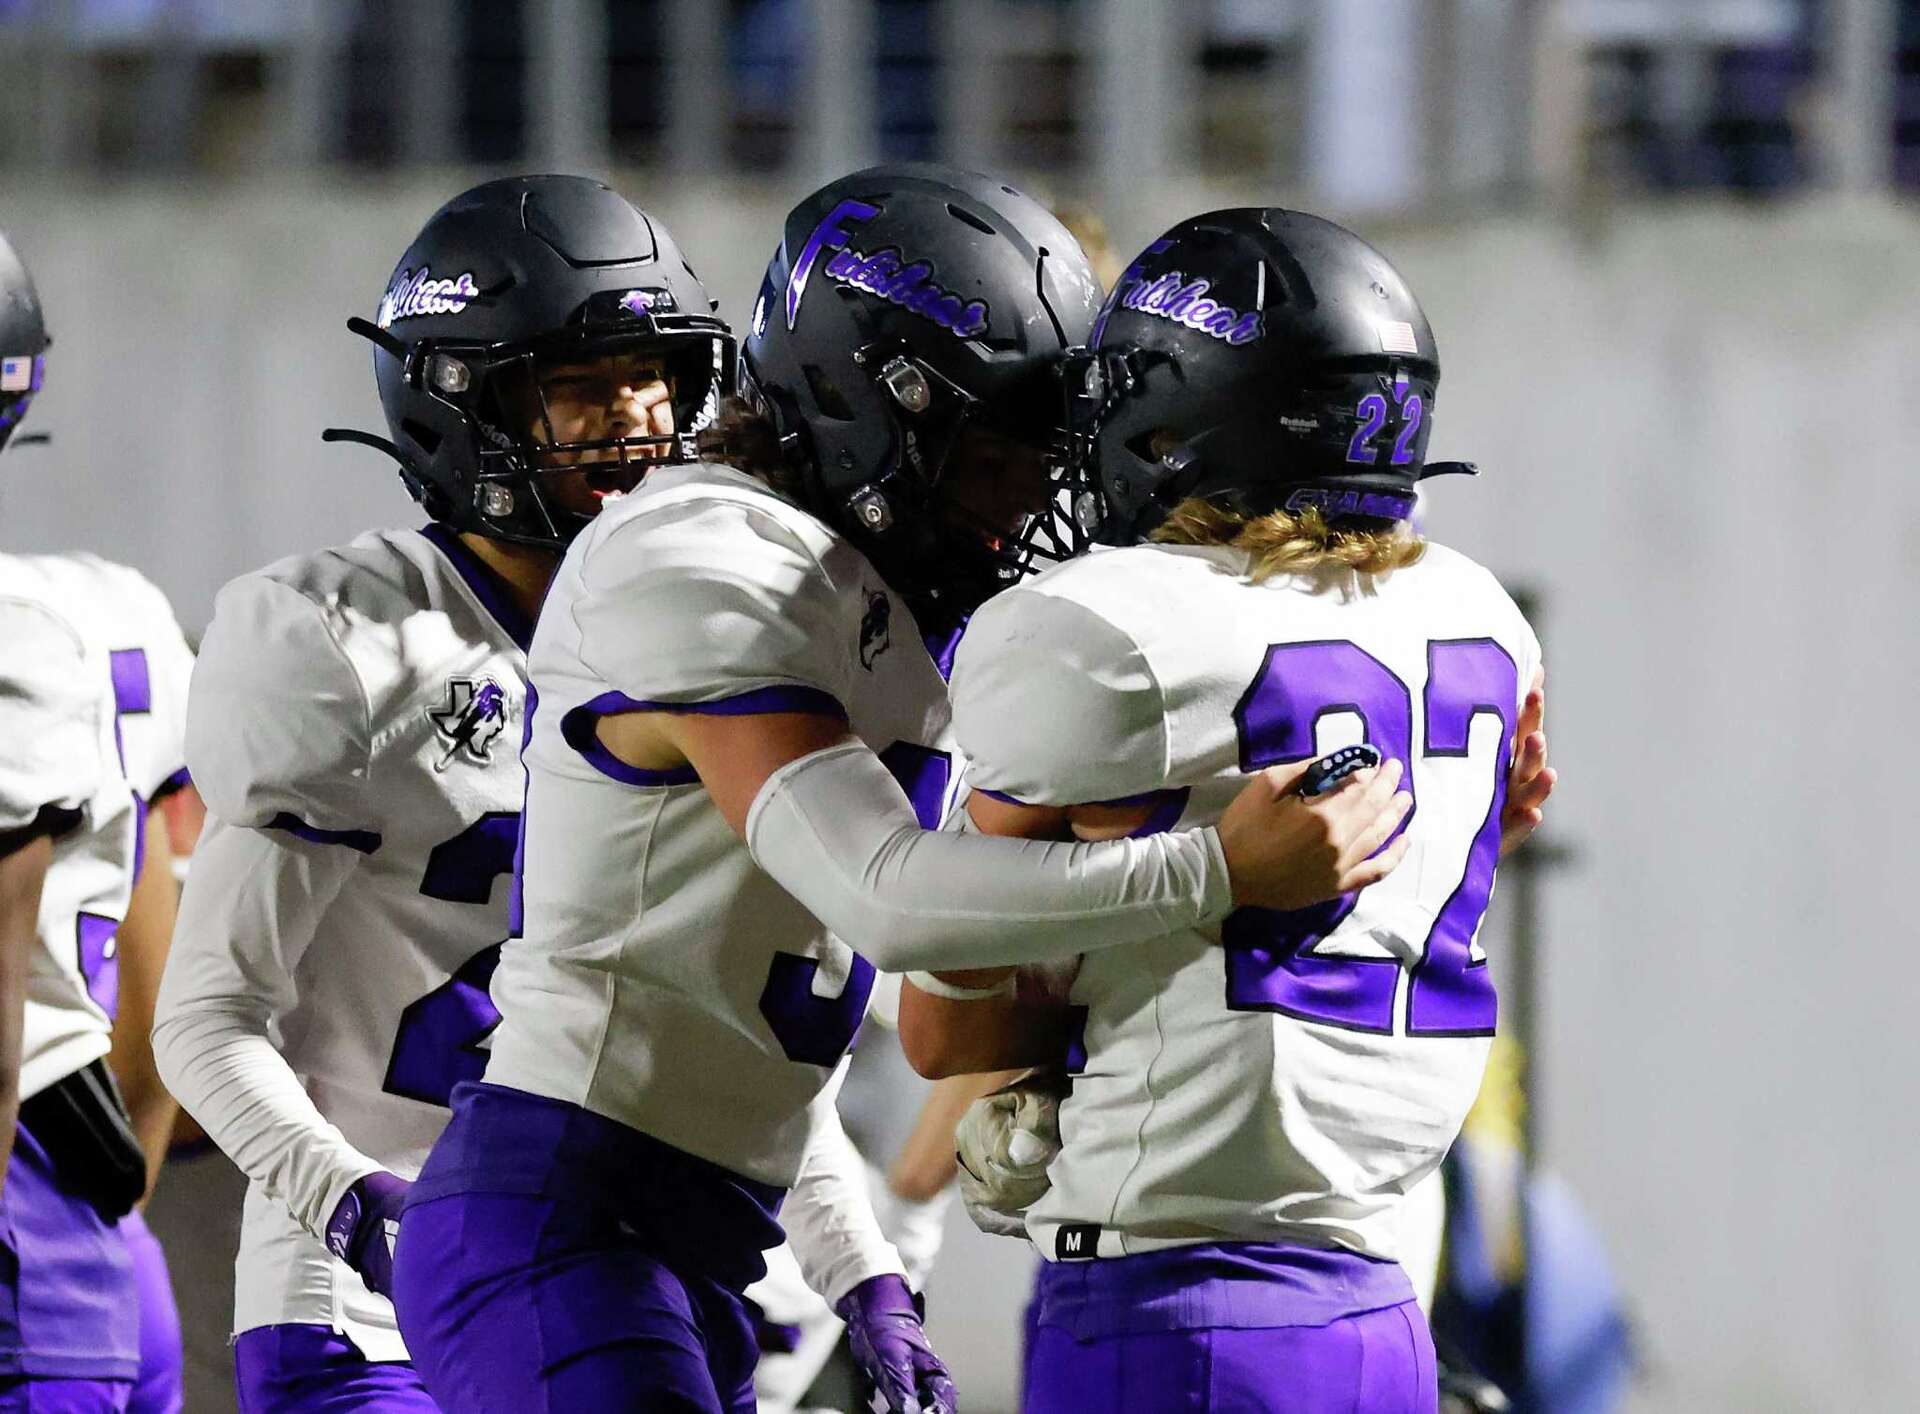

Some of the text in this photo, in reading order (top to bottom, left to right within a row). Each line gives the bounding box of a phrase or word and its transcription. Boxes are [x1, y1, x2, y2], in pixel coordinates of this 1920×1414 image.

[1345, 392, 1423, 465] 22
[1222, 637, 1518, 1038] 22
[1066, 1231, 1081, 1251] M
